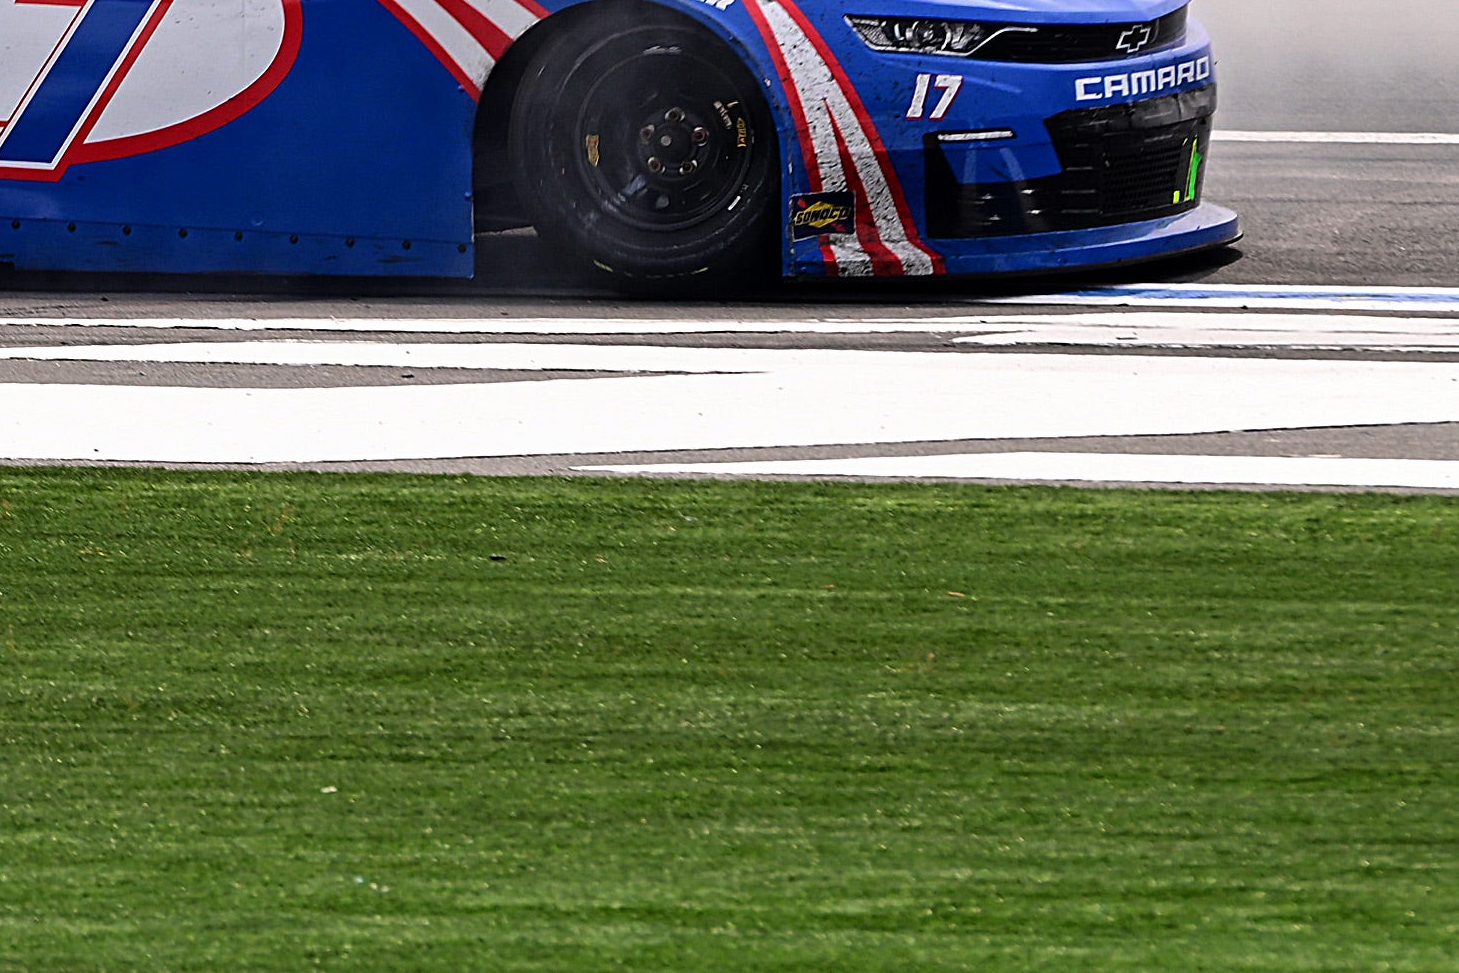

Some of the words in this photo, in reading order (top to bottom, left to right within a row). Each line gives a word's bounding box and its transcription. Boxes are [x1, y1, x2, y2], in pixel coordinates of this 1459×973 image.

[905, 73, 964, 120] 17
[1075, 56, 1210, 101] CAMARO
[793, 207, 851, 225] SUNOCO
